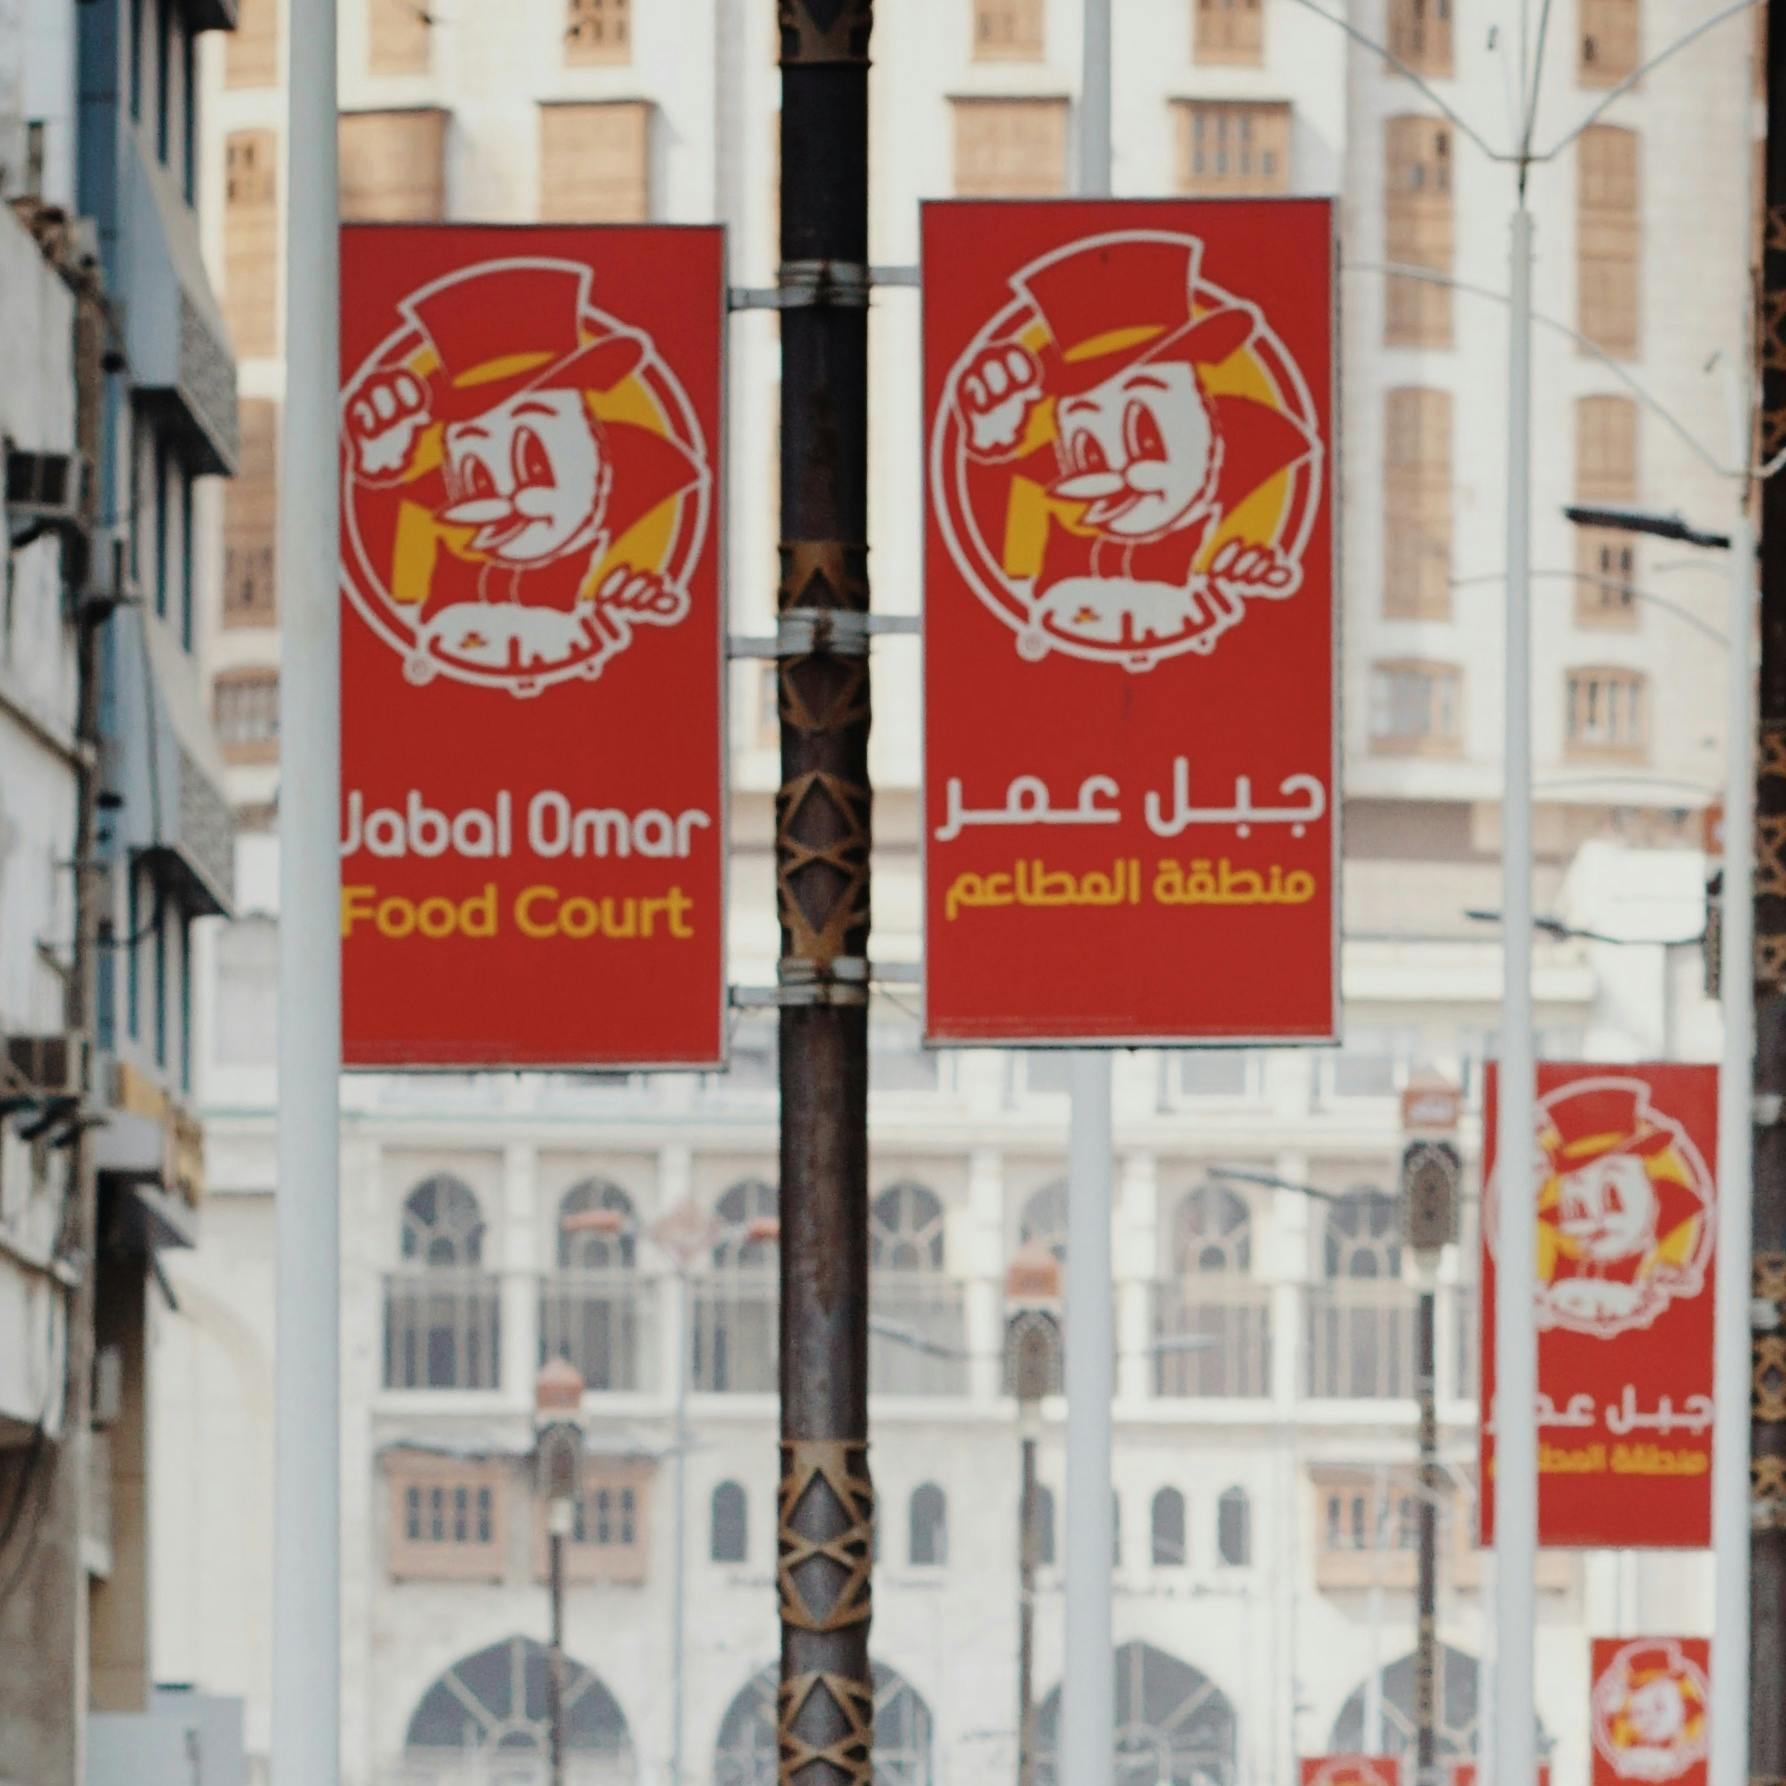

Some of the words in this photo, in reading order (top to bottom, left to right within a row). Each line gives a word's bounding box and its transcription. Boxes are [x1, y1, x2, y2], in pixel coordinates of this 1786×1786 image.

[340, 789, 512, 858] Jabal
[527, 789, 711, 858] Omar
[934, 774, 1121, 842] عمر
[1145, 756, 1326, 839] جبل
[340, 882, 498, 938] Food
[514, 885, 694, 938] Court
[945, 857, 1141, 921] المطاعم
[1153, 857, 1317, 905] منطقة
